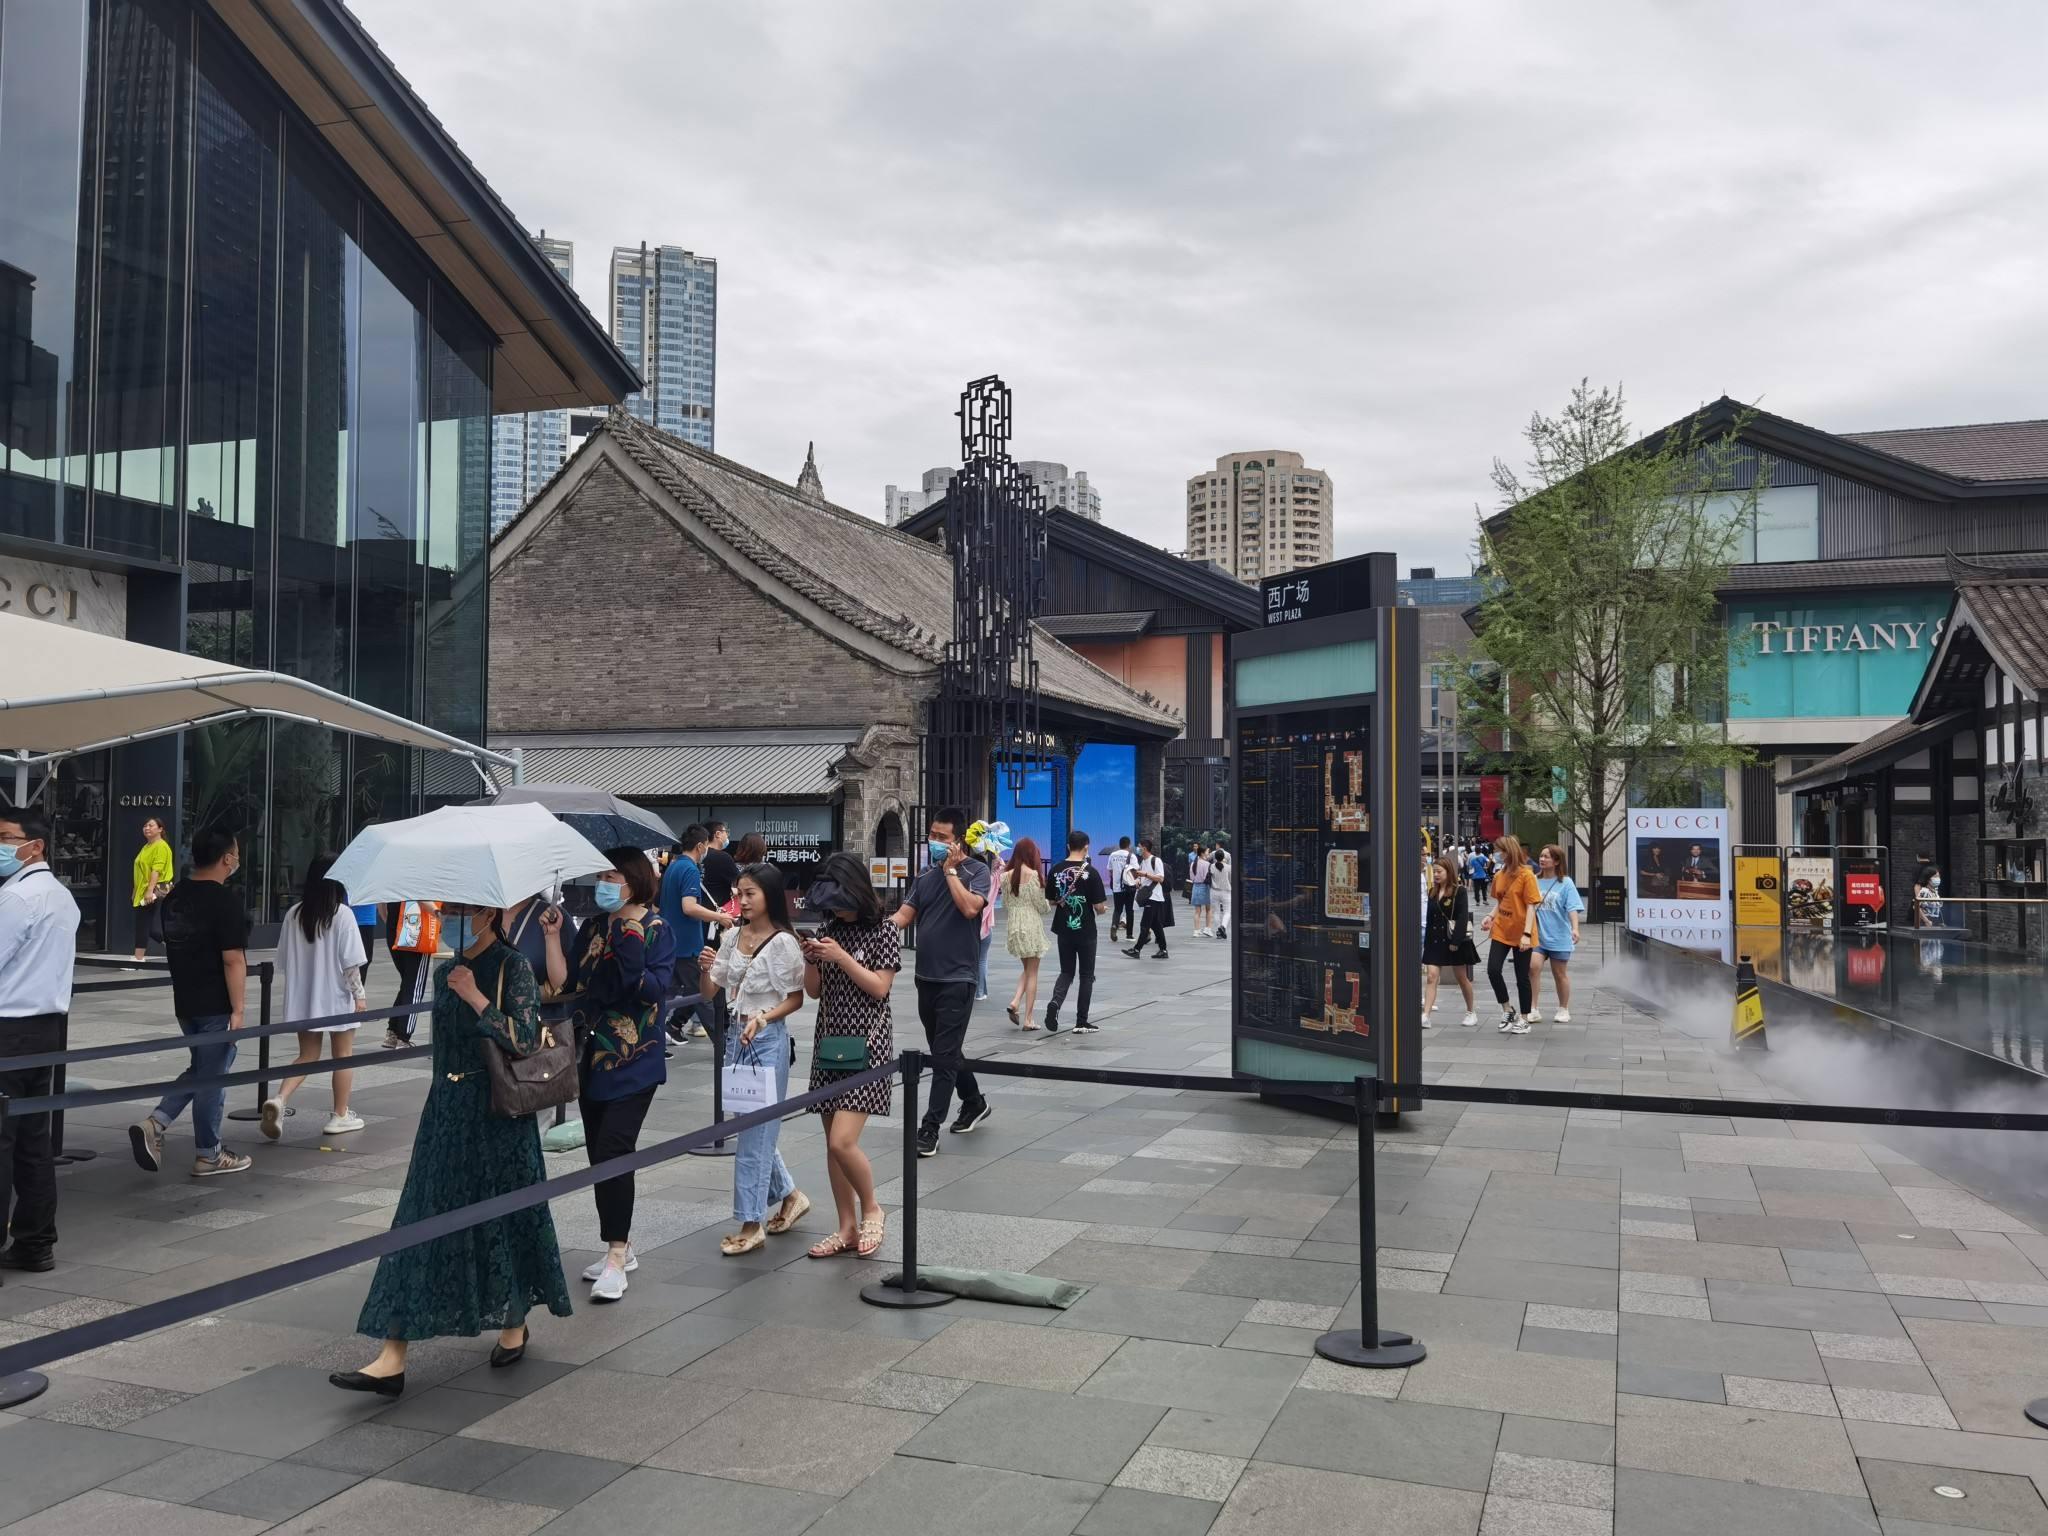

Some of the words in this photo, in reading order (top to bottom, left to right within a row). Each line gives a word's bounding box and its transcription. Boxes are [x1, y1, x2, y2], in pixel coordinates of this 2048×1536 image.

[1267, 580, 1310, 609] 西广场
[1268, 611, 1283, 624] WEST
[1284, 608, 1302, 620] PLAZA
[1751, 621, 1927, 653] TIFFANY
[120, 795, 171, 807] GUCCI
[755, 821, 798, 833] CUSTOMER
[1635, 815, 1720, 829] GUCCI
[789, 835, 820, 846] CENTRE
[763, 850, 821, 862] 户服务中心
[1637, 908, 1721, 920] BELOVED
